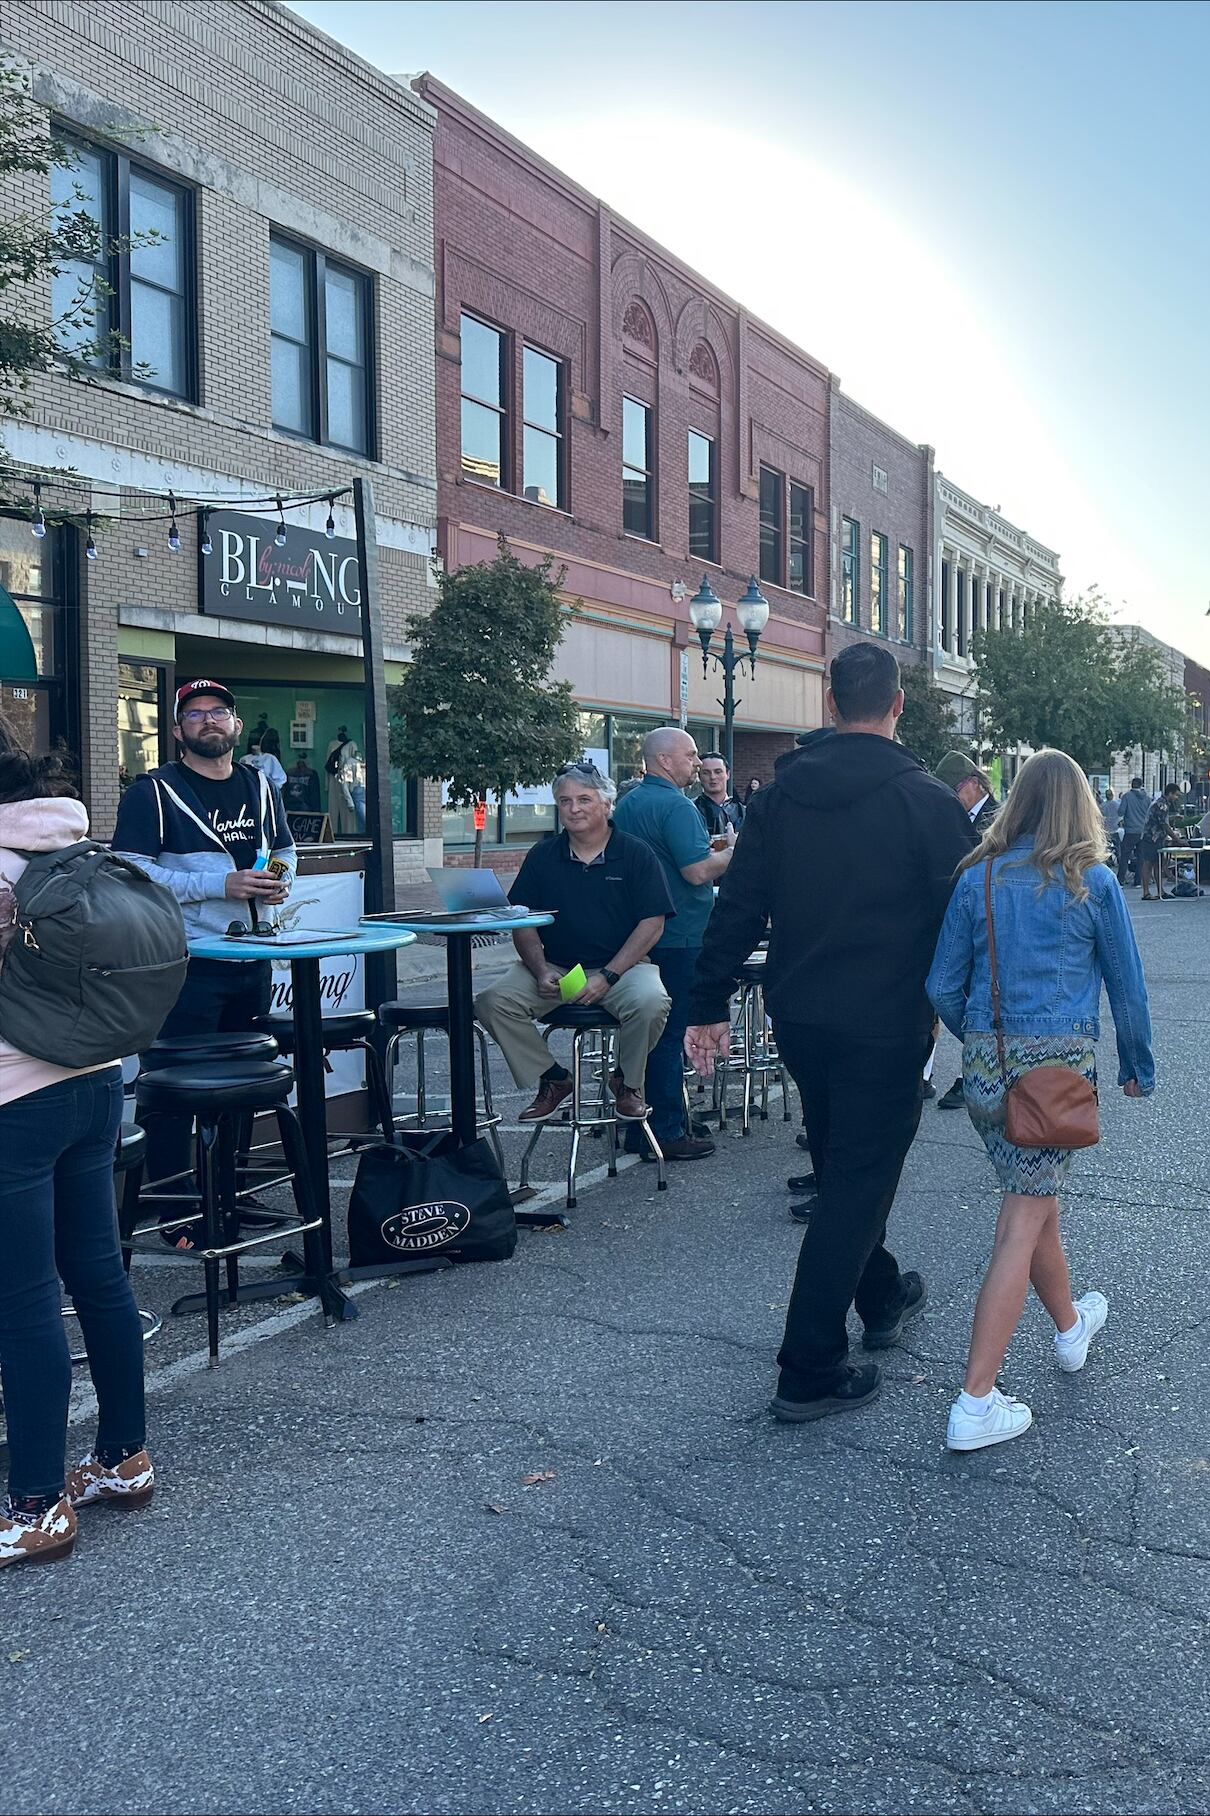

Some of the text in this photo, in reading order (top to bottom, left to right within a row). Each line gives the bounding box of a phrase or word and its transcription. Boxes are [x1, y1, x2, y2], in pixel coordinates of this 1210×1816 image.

[220, 583, 363, 618] GLAMOU
[401, 1204, 446, 1224] STEVE
[392, 1222, 460, 1247] MADDEN
